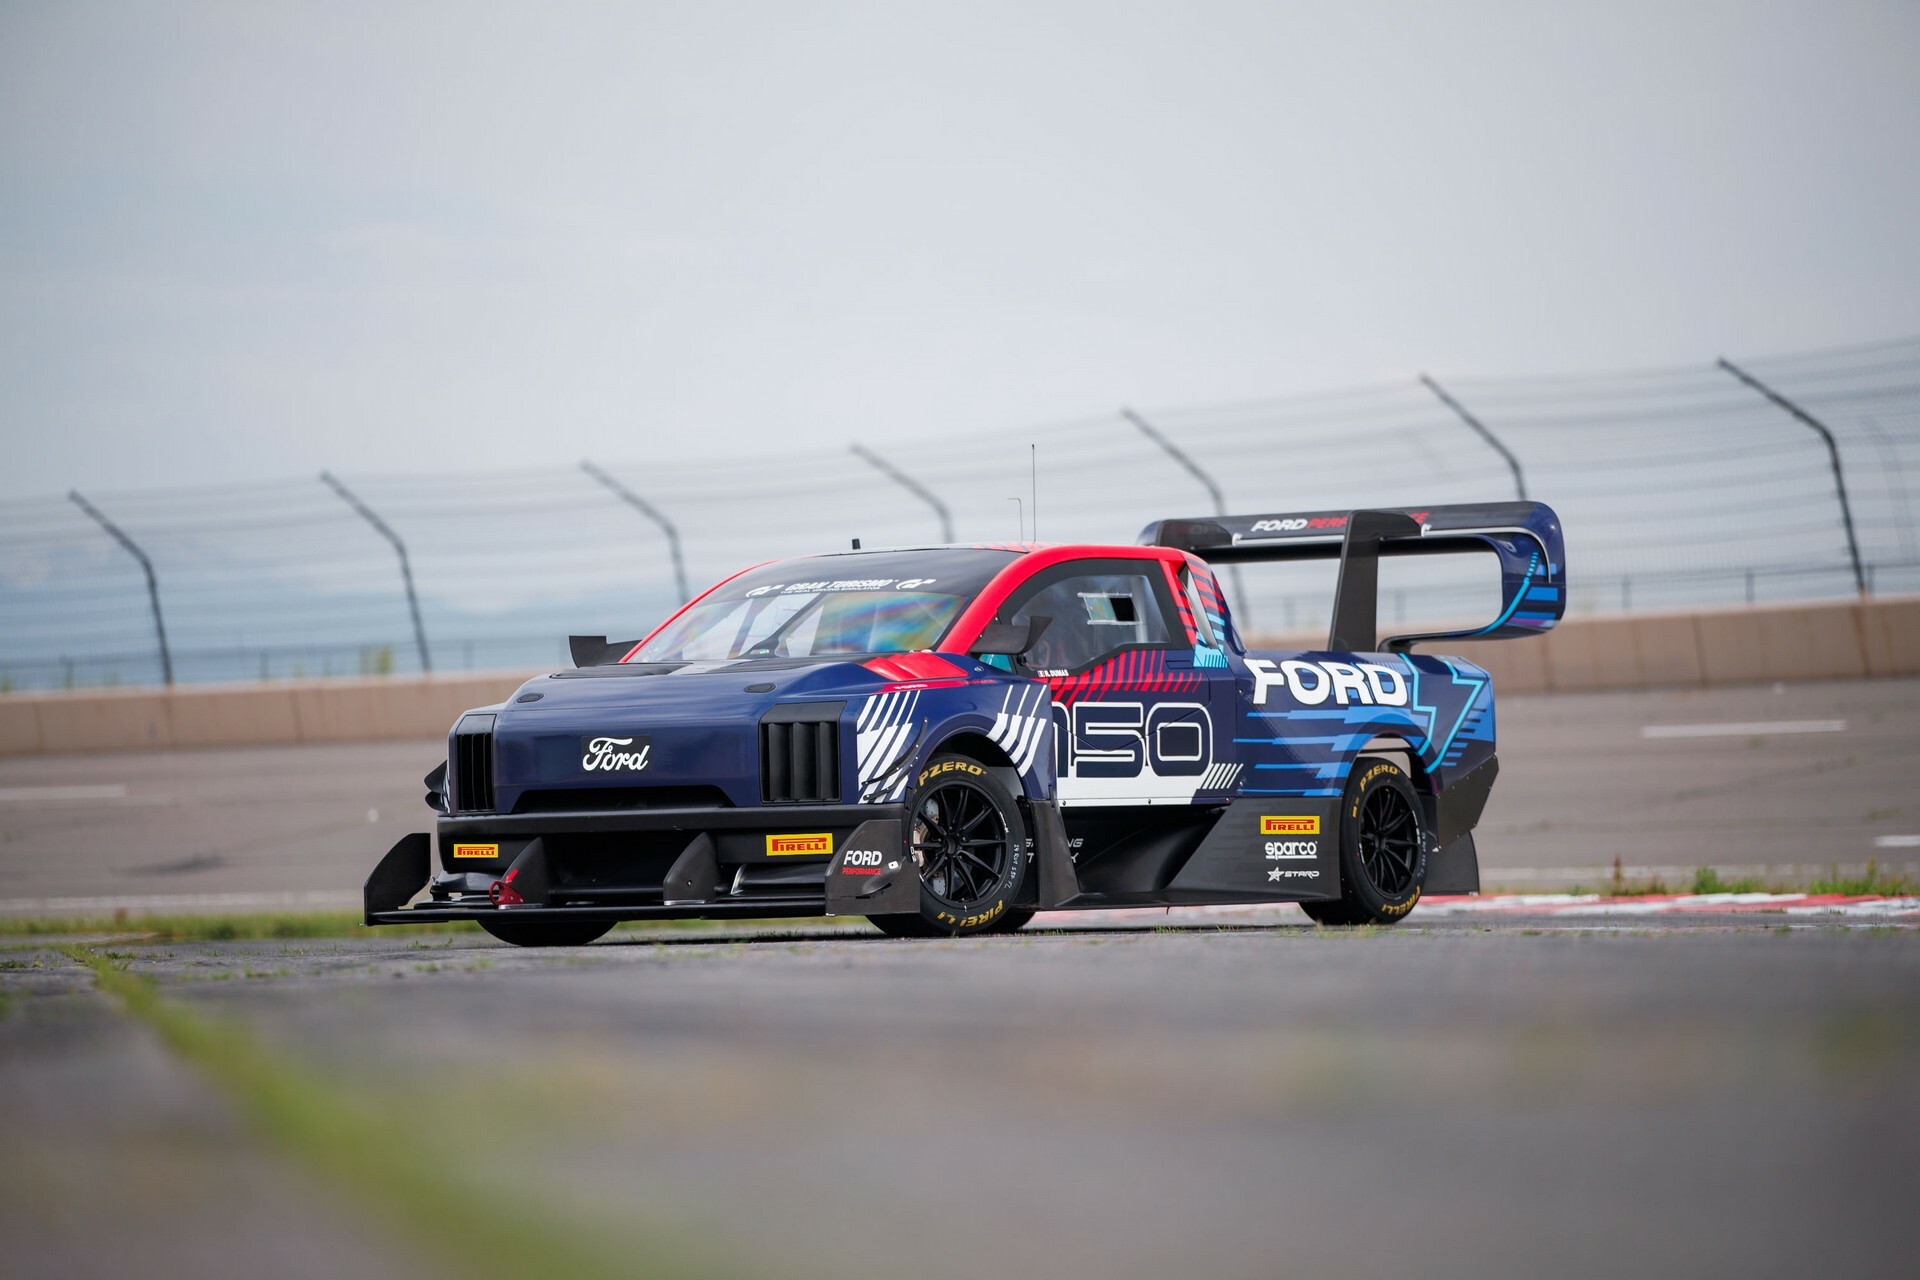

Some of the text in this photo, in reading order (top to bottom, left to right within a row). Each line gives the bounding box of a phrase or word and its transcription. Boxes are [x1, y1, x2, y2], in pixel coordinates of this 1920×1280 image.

[1251, 519, 1308, 532] FORD
[785, 581, 831, 592] GRAN
[827, 579, 894, 589] TURISMO
[1243, 658, 1409, 706] FORD
[582, 736, 650, 771] Ford
[1265, 819, 1315, 830] PIRELLI
[457, 846, 495, 856] PIRELLI
[772, 837, 827, 852] PIRELLI
[1264, 841, 1318, 860] sparco
[843, 850, 883, 866] FORD
[842, 867, 881, 876] PERFORMANCE
